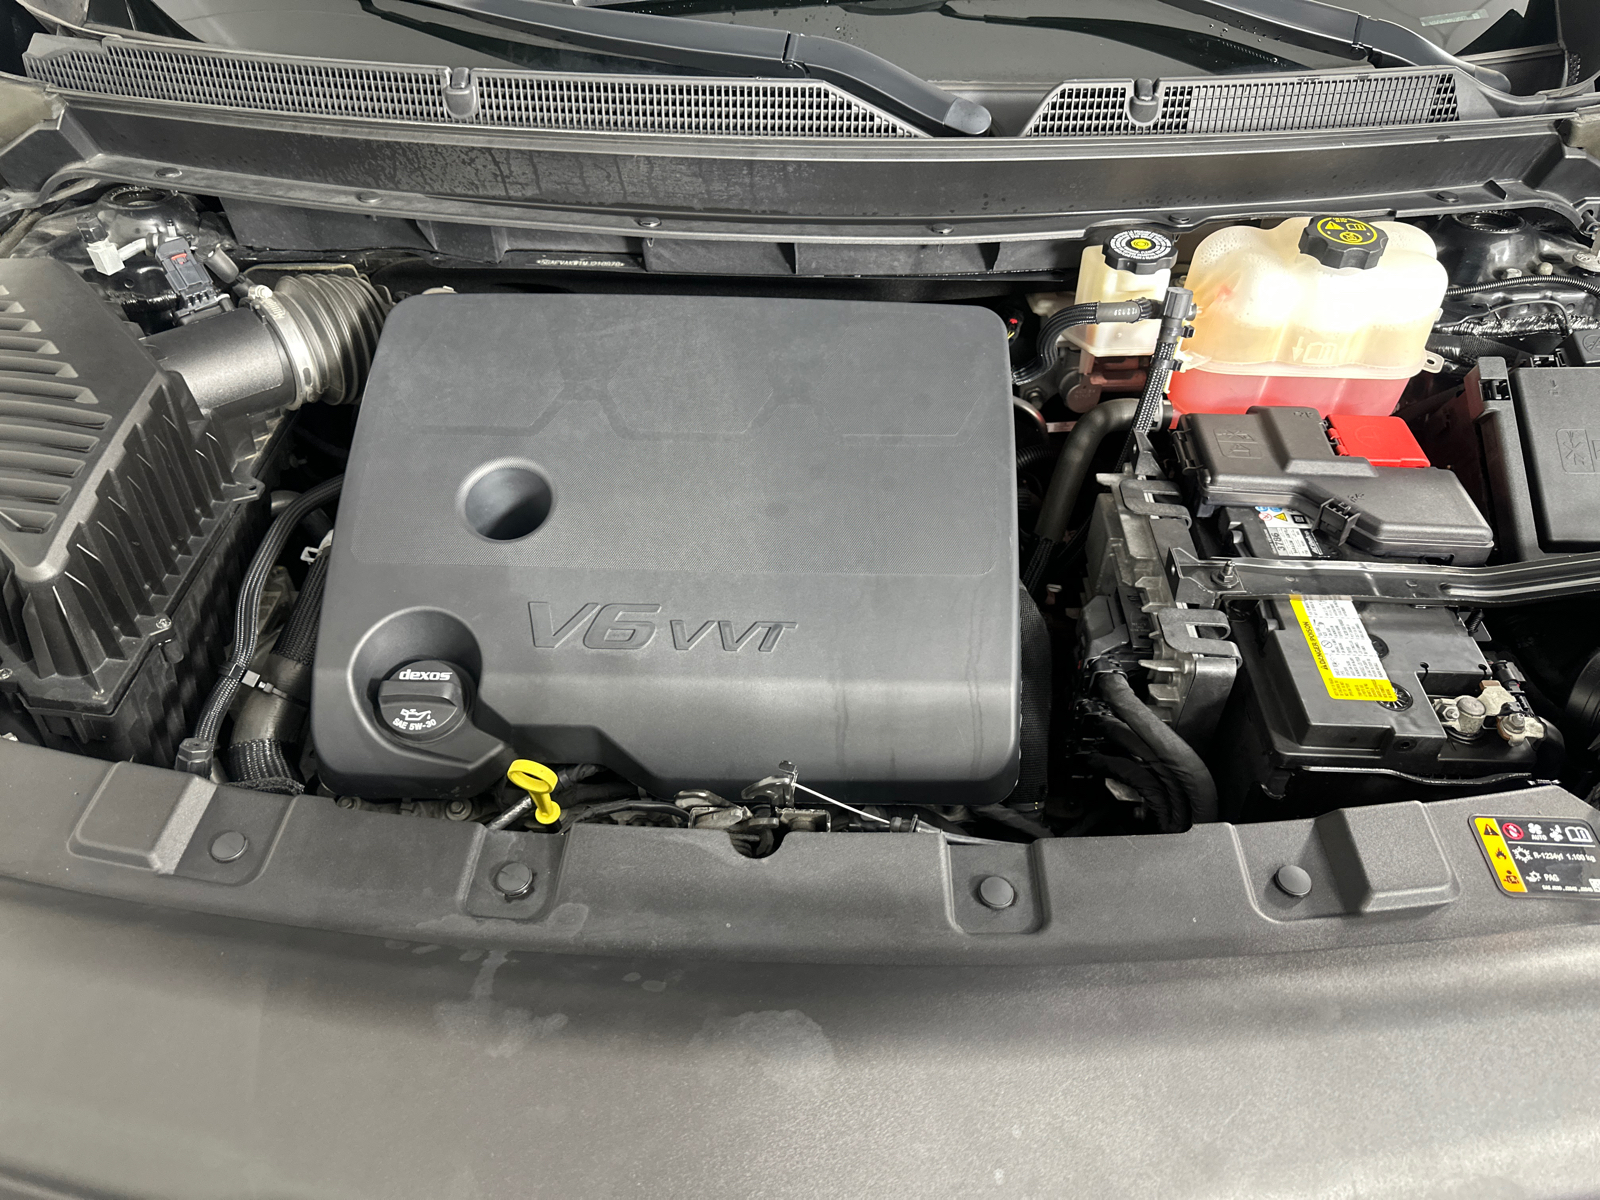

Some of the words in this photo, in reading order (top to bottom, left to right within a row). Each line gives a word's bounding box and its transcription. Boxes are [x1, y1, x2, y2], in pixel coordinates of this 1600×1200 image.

[1271, 532, 1286, 551] 3786
[528, 601, 662, 650] V6
[670, 619, 798, 652] VVT
[399, 669, 453, 681] dexos
[392, 718, 409, 730] SAE
[409, 719, 437, 730] 5W-30
[1543, 874, 1560, 882] PAG
